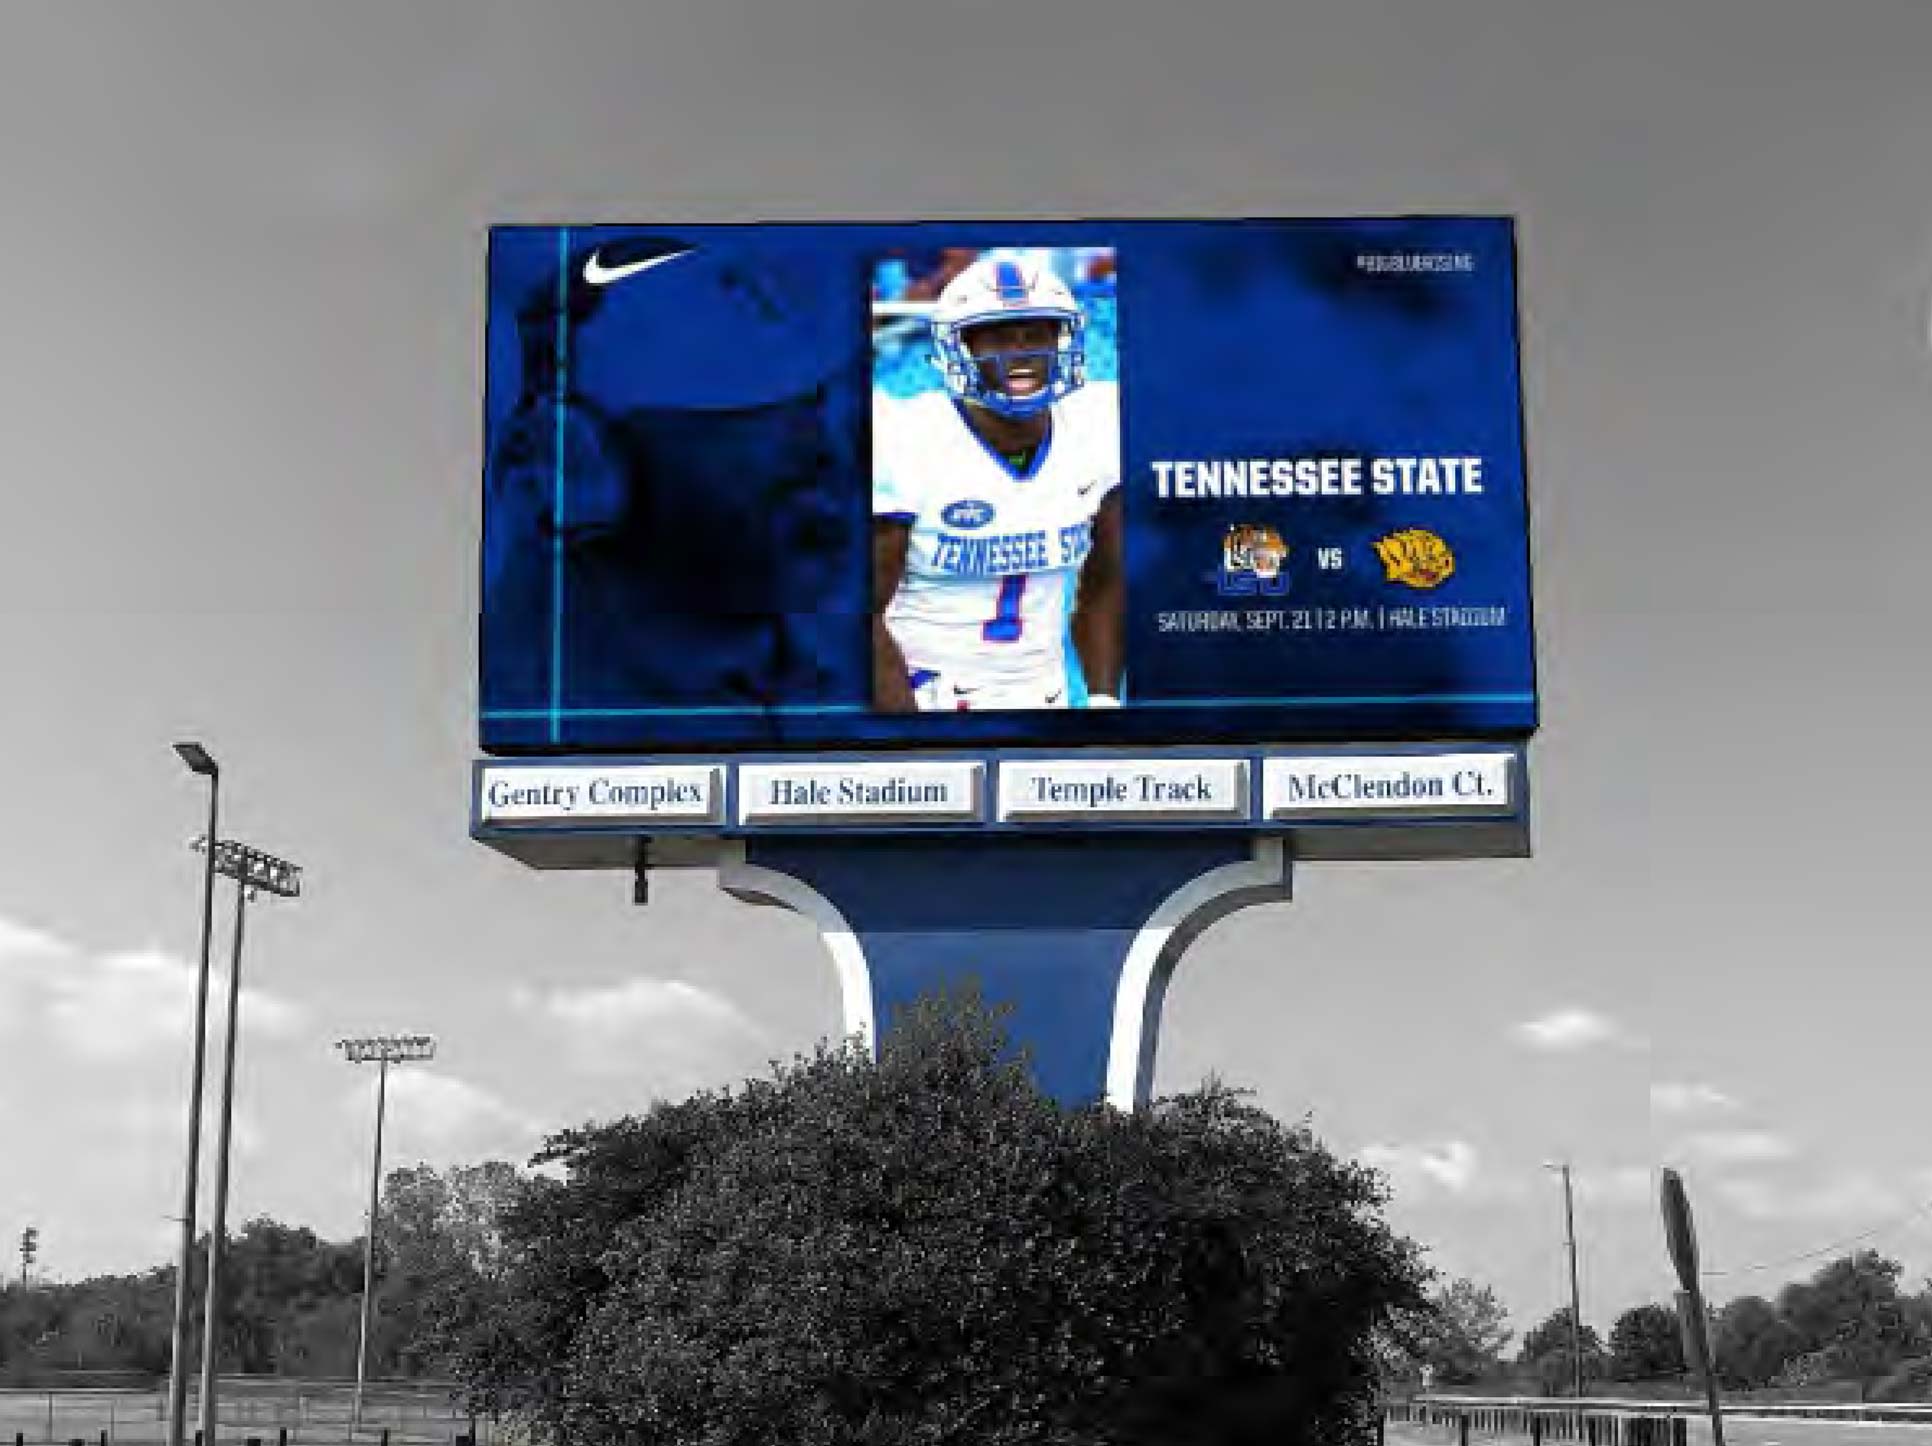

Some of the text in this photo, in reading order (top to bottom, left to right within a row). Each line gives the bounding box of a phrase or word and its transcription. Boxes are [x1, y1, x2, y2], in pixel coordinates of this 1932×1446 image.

[1151, 456, 1484, 498] TENNESSEE STATE
[931, 531, 1047, 577] TENNESSEE
[1317, 547, 1343, 570] VS
[979, 574, 1024, 641] 1
[1246, 610, 1289, 631] SEPT.
[1291, 609, 1313, 630] 21
[1388, 607, 1428, 629] HALE
[488, 778, 703, 810] Gentry Complex
[770, 775, 949, 805] Hale Stadium
[1030, 773, 1213, 807] Temple Track
[1288, 770, 1493, 800] McClendon Ct.
